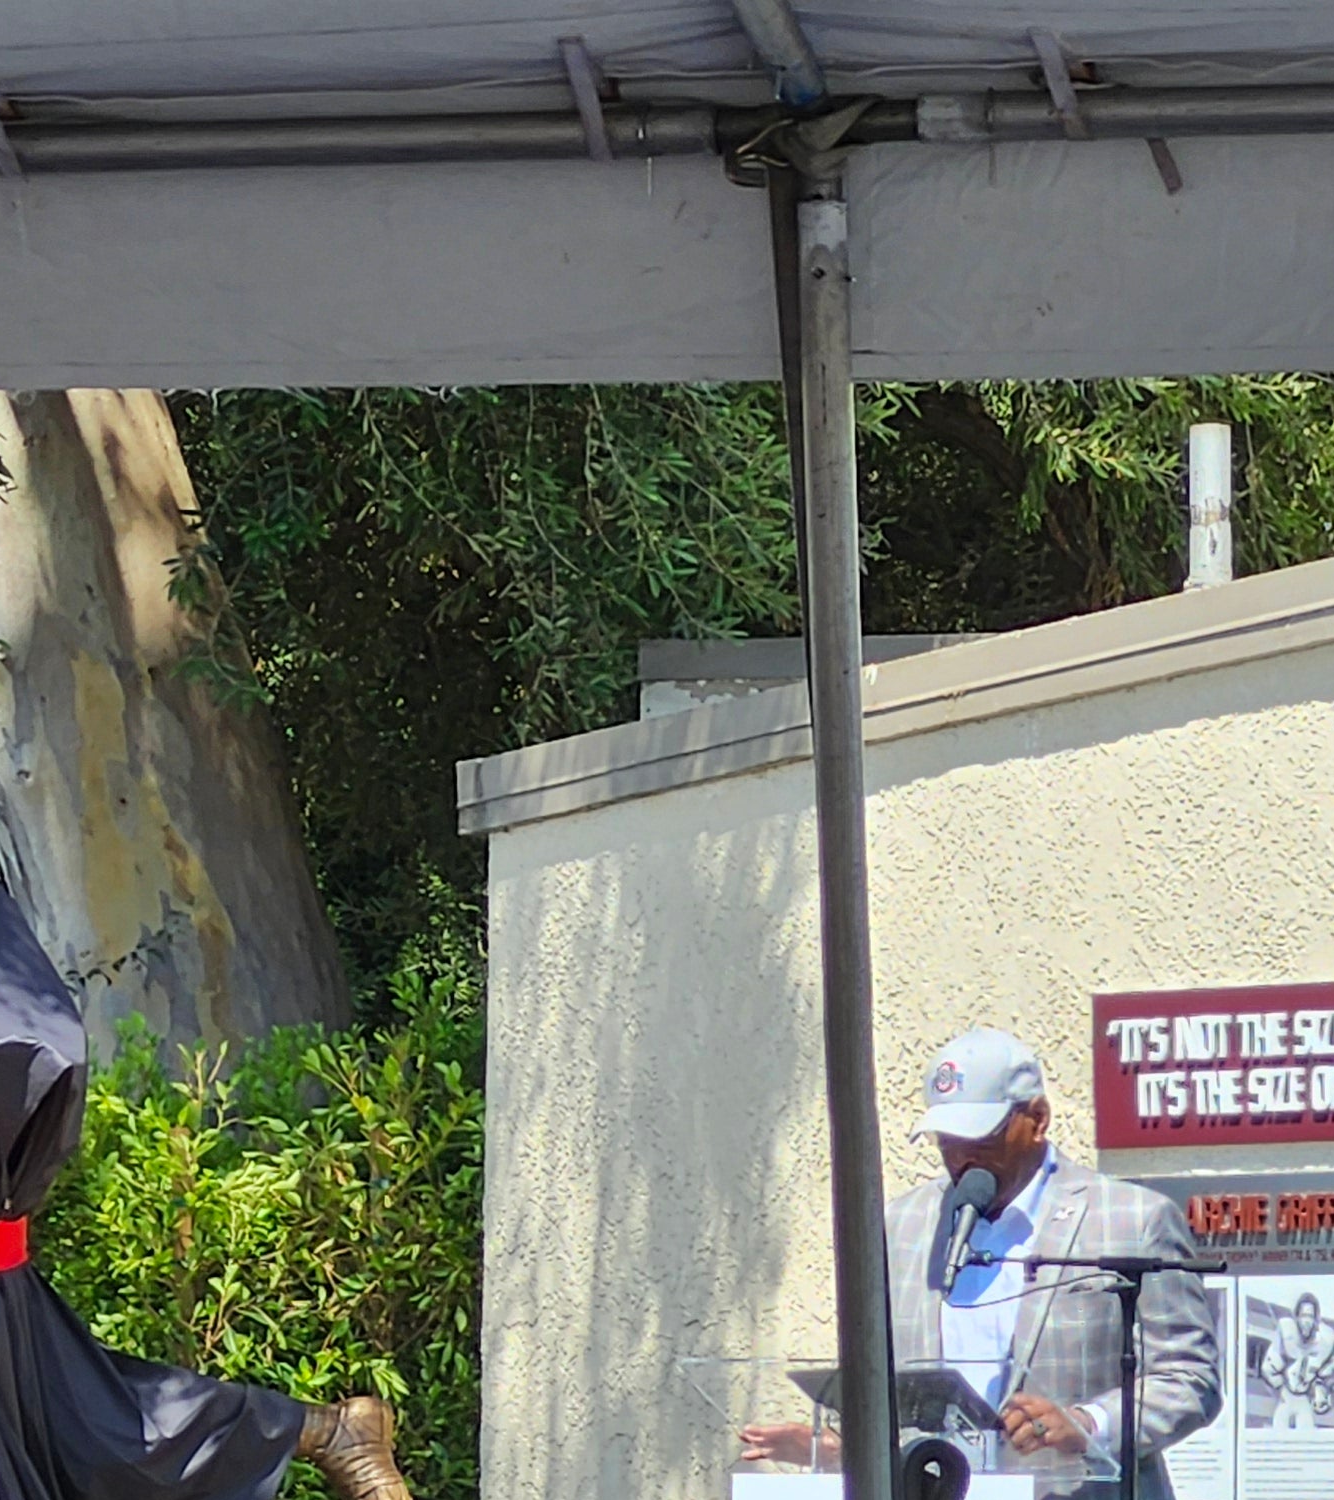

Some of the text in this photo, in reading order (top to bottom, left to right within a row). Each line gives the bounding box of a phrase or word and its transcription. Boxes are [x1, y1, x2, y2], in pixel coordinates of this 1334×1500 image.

[1174, 1014, 1232, 1060] NOT
[1235, 1012, 1288, 1057] THE
[1137, 1071, 1188, 1117] IT'S
[1191, 1069, 1244, 1115] THE
[1247, 1067, 1307, 1113] SIZE
[1186, 1193, 1270, 1235] ARCHIE
